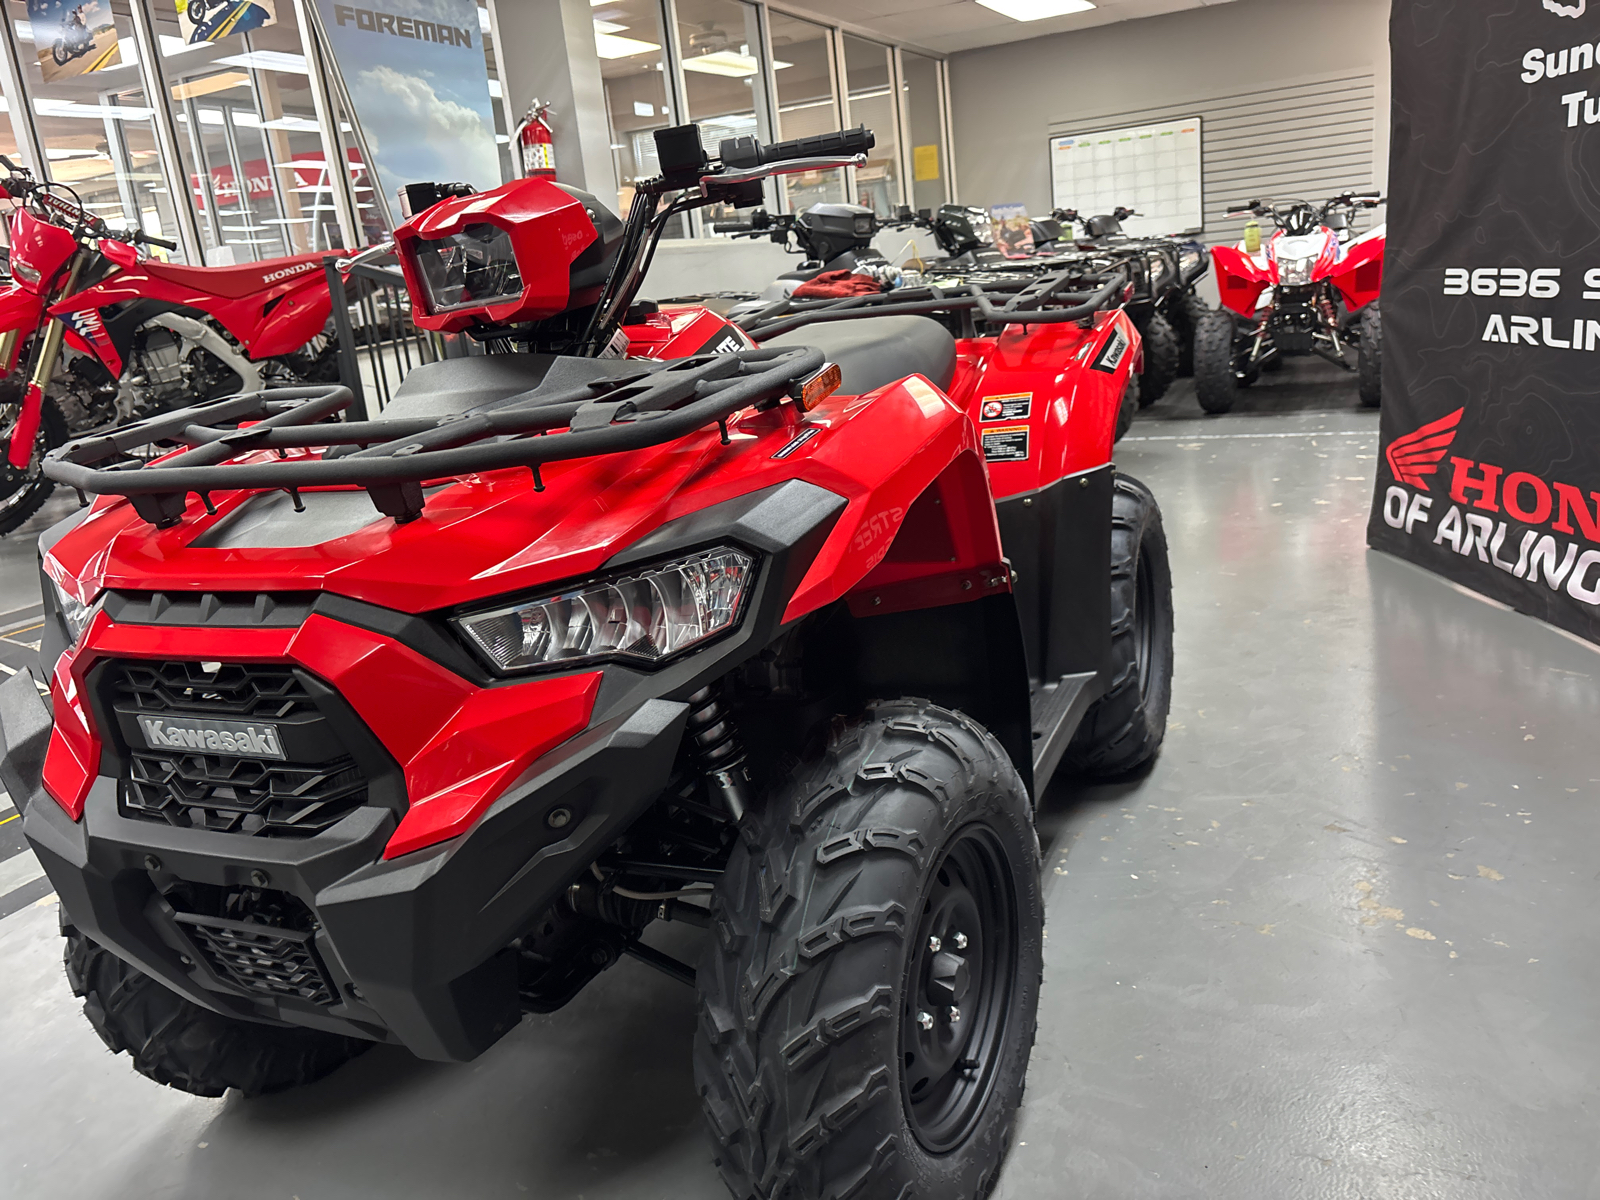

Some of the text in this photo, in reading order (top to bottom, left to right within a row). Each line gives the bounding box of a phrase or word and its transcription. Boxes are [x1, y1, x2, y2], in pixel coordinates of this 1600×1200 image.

[334, 4, 472, 49] FOREMAN
[1521, 42, 1600, 84] Sun
[262, 262, 317, 284] HONDA
[1443, 267, 1561, 298] 3636
[1105, 336, 1127, 367] Kawasaki
[1449, 456, 1600, 543] HON
[1384, 485, 1600, 605] OF ARLING
[145, 720, 281, 755] Kawasaki
